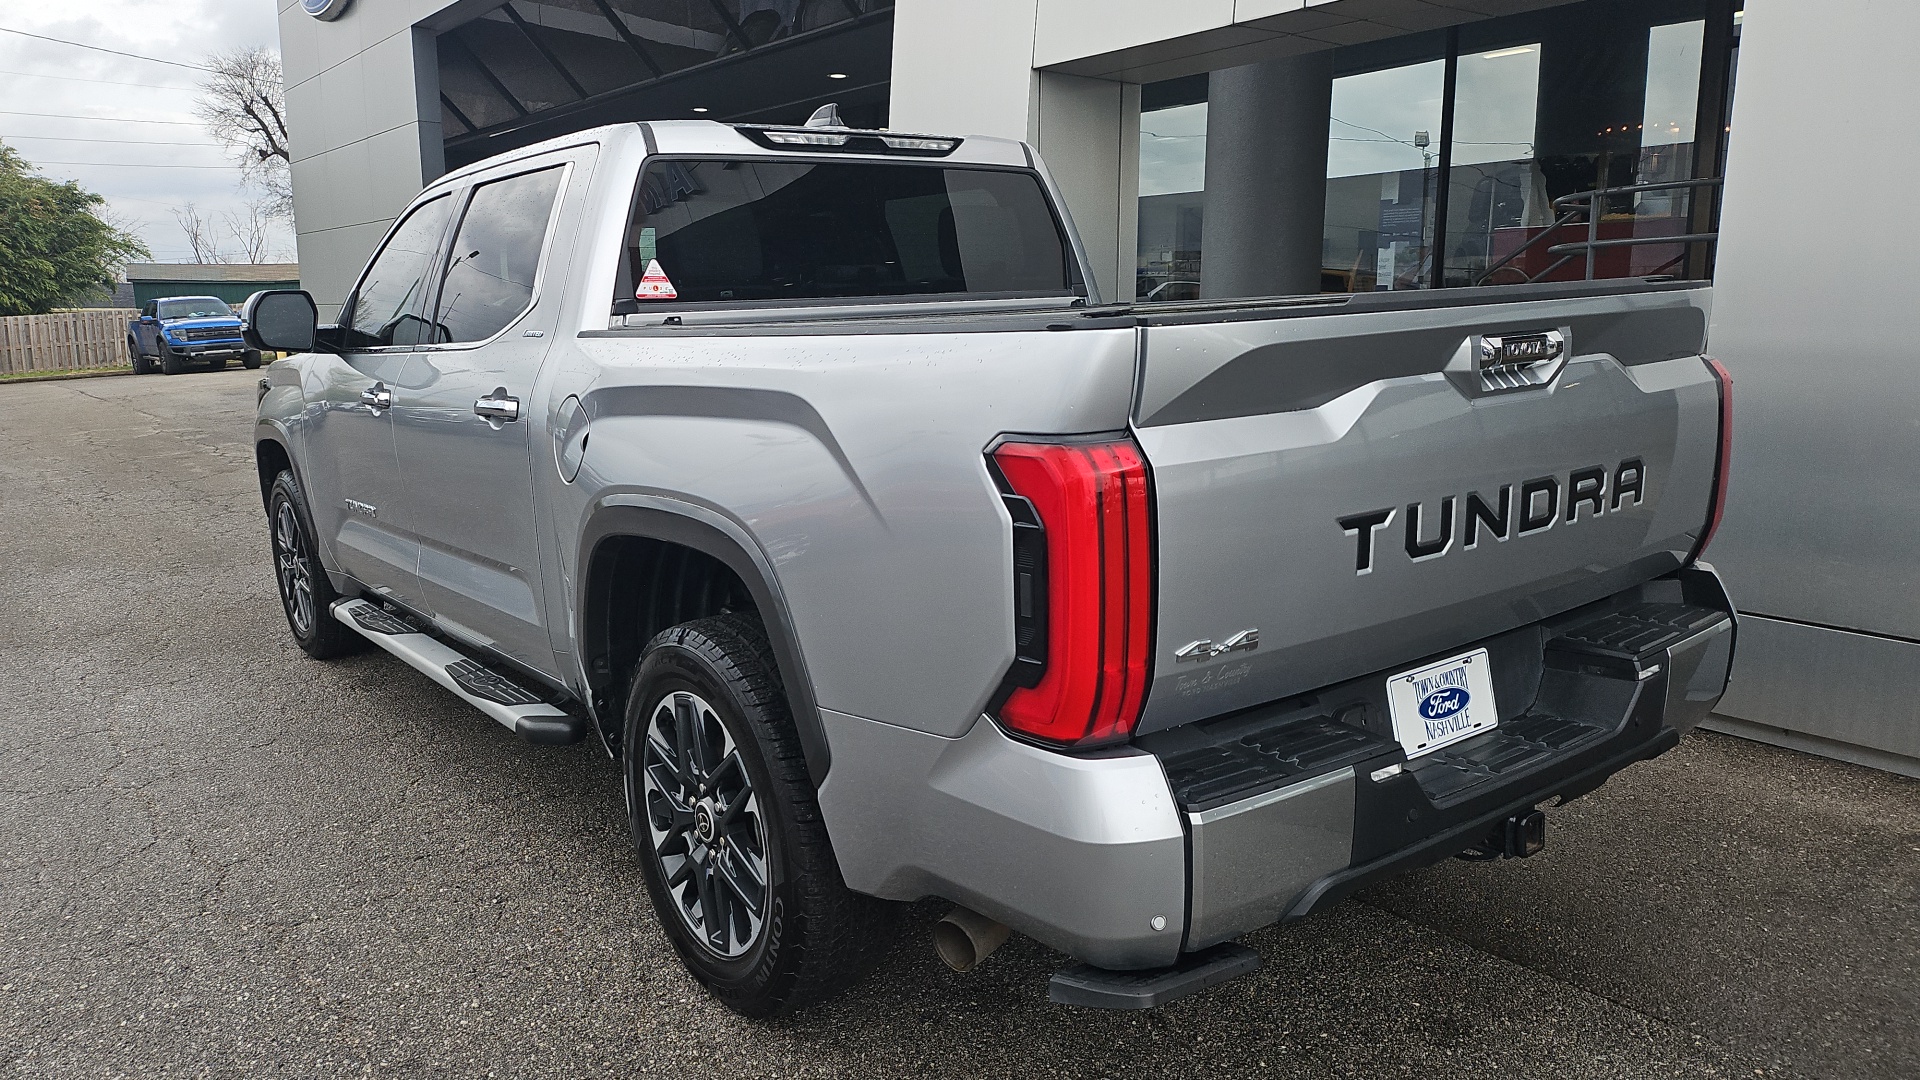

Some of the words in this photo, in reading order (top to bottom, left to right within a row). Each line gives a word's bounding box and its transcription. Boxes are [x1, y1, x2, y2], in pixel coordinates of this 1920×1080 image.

[1505, 341, 1544, 357] TOYOTA
[1335, 455, 1647, 577] TUNDRA
[1412, 676, 1434, 706] TOWN
[1434, 674, 1441, 689] &
[1440, 665, 1469, 690] COUNTRY
[1428, 690, 1460, 717] Ford
[1424, 707, 1472, 742] NASHVILLE
